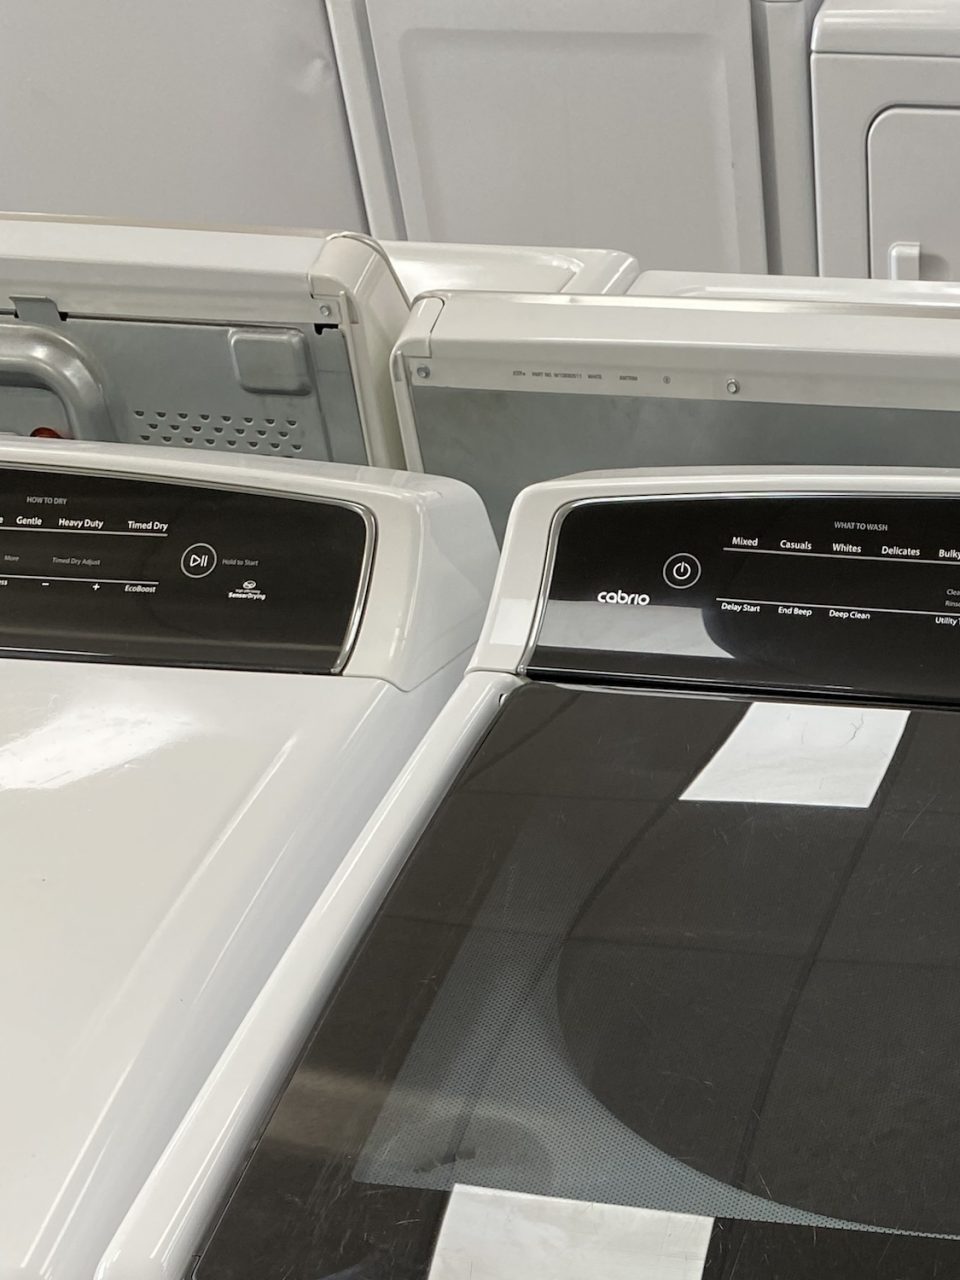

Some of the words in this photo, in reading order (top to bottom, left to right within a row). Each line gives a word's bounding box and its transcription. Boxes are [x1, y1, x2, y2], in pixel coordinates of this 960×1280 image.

[27, 496, 42, 504] HOW
[43, 497, 52, 505] TO
[53, 497, 67, 506] DRY
[16, 515, 42, 526] Gentle
[58, 517, 83, 529] Heavy
[84, 519, 104, 529] Duty
[127, 520, 152, 530] Timed
[153, 521, 168, 532] Dry
[834, 521, 855, 530] WHAT
[856, 522, 866, 531] TO
[867, 523, 888, 532] WASH
[732, 536, 758, 547] Mixed
[780, 539, 812, 550] Casuals
[832, 543, 862, 553] Whites
[881, 545, 920, 556] Delicates
[52, 556, 70, 565] Timed
[71, 558, 81, 566] Dry
[82, 558, 101, 567] Adjust
[244, 559, 259, 567] Start
[124, 584, 156, 593] EcoBoost
[597, 590, 650, 606] cabrio
[721, 602, 742, 613] Delay
[743, 604, 761, 612] Start
[945, 600, 960, 608] Rinse
[778, 606, 793, 615] End
[794, 607, 812, 617] Beep
[829, 609, 849, 619] Deep
[850, 610, 871, 619] Clean
[935, 616, 957, 626] Utility
